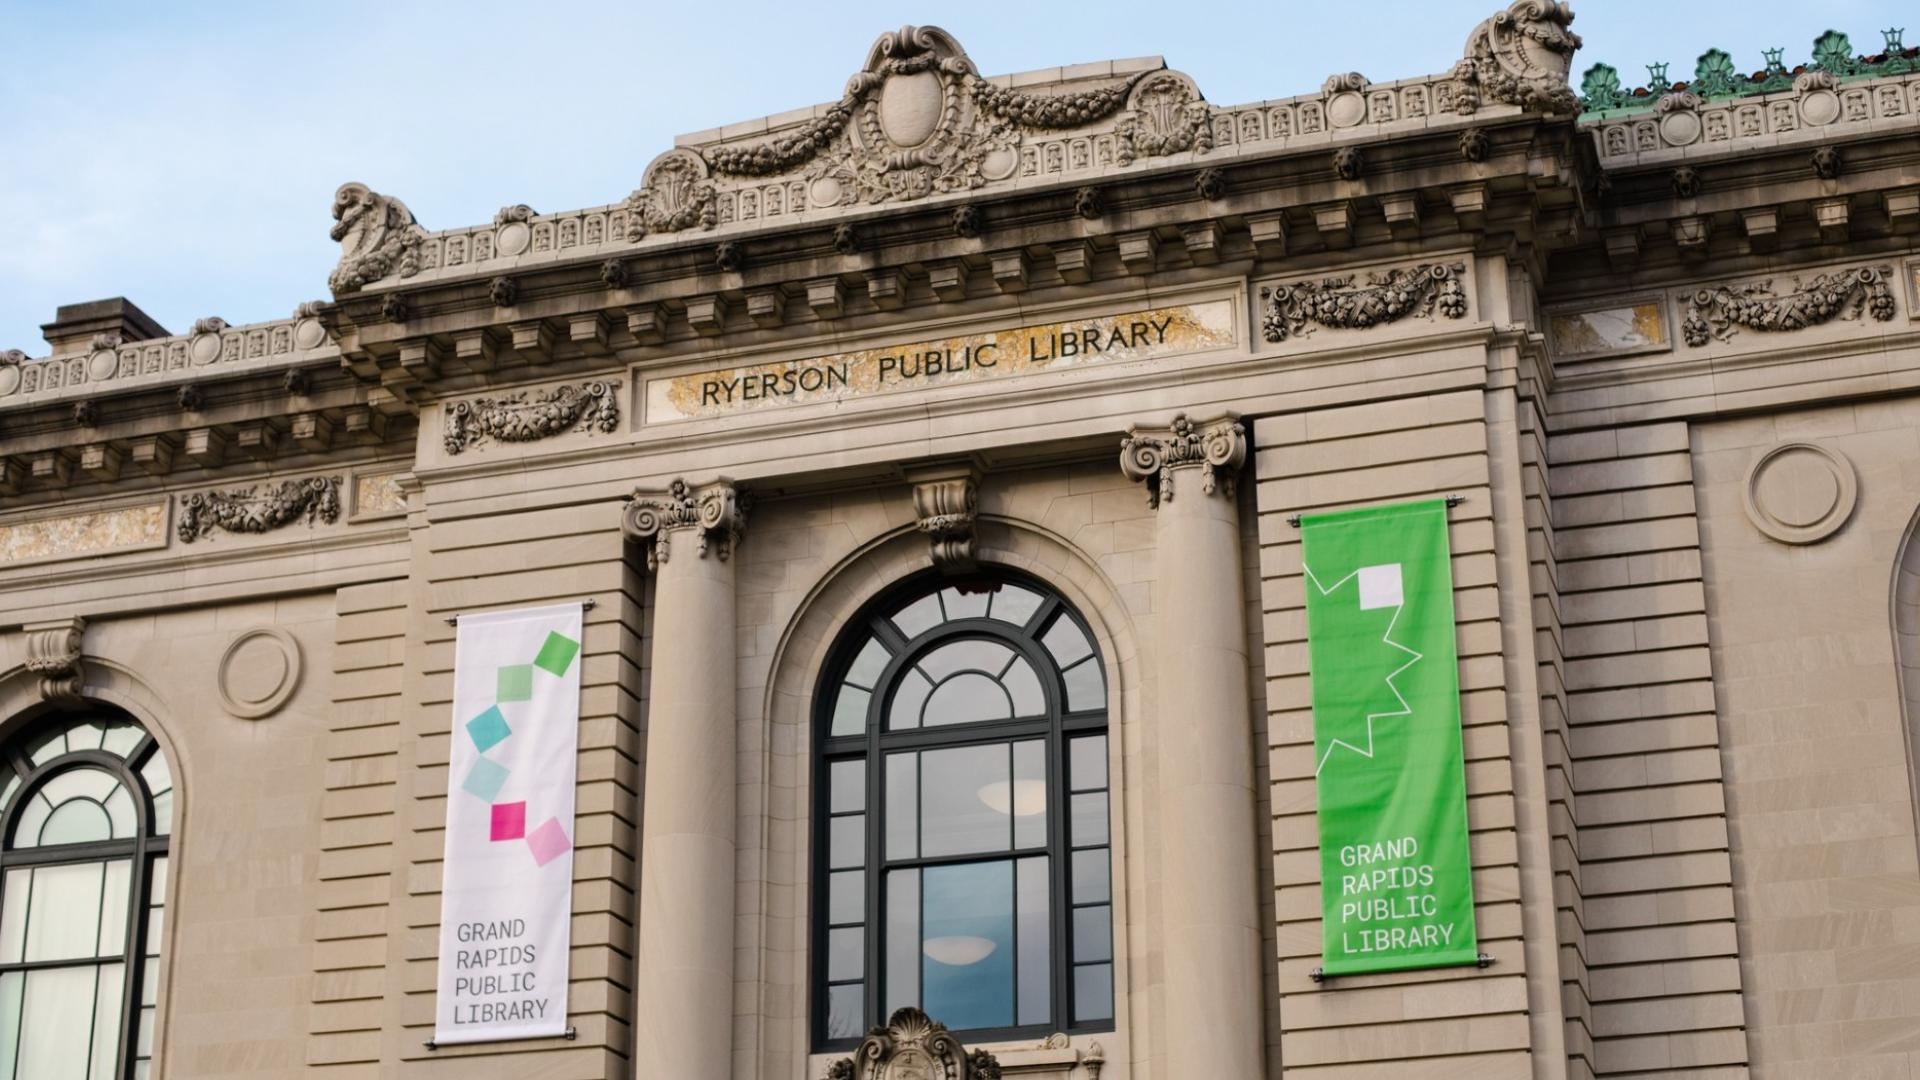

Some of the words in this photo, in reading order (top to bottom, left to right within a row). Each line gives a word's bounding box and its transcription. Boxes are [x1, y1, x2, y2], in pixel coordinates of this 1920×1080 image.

[702, 363, 848, 406] RYERSON
[878, 343, 998, 382] PUBLIC
[1030, 317, 1172, 362] LIBRARY
[1340, 836, 1418, 867] GRAND
[1342, 865, 1434, 896] RAPIDS
[1342, 894, 1437, 924] PUBLIC
[457, 918, 526, 943] GRAND
[1343, 922, 1454, 954] LIBRARY
[456, 944, 536, 970] RAPIDS
[455, 971, 536, 997] PUBLIC
[454, 998, 549, 1025] LIBRARY
